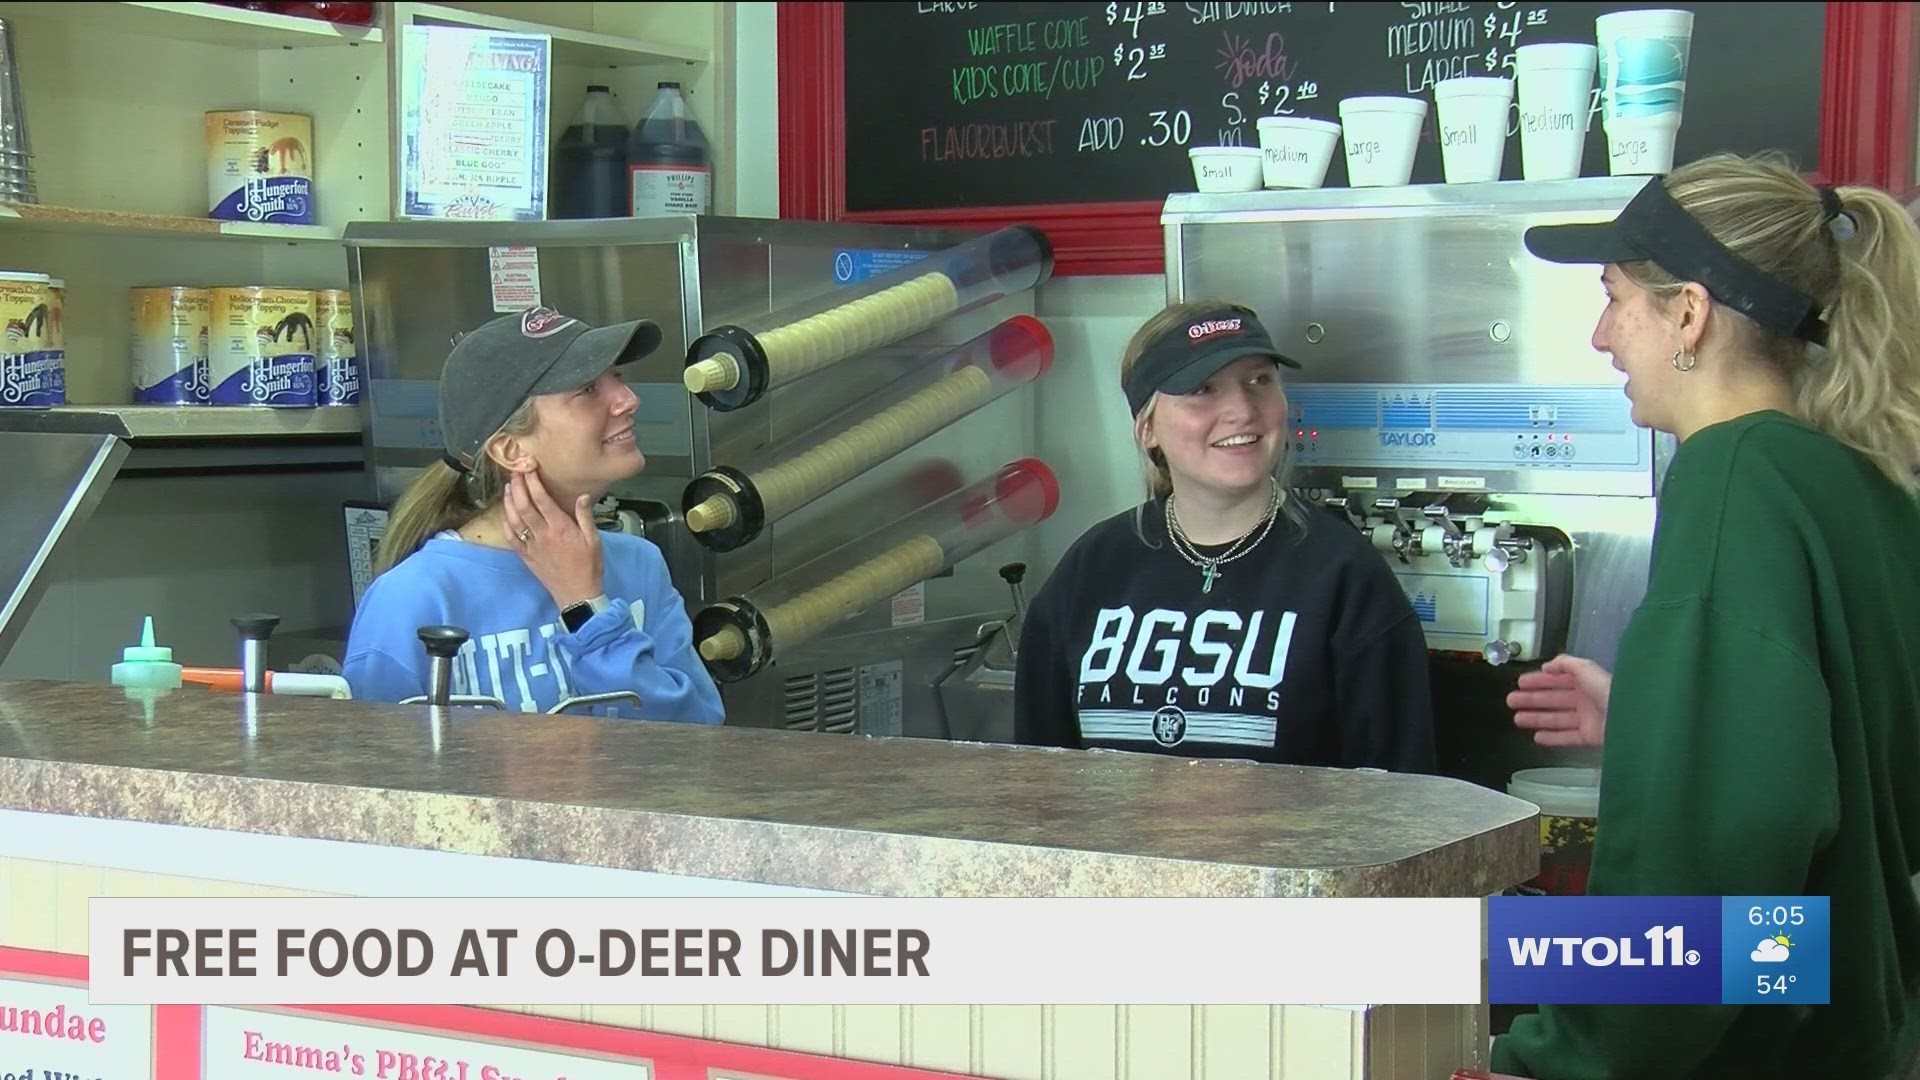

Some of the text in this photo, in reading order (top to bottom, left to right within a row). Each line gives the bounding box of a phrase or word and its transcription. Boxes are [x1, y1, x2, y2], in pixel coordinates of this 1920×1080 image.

[968, 21, 1037, 56] WAFFLE
[1044, 17, 1090, 50] CONE
[1387, 17, 1475, 58] MEDIUM
[952, 66, 999, 105] KIDS
[255, 119, 280, 129] Fudge
[922, 110, 1192, 160] FLAVORBURST ADD .30
[1443, 125, 1477, 147] Small
[483, 148, 518, 157] CHERRY
[1347, 141, 1381, 164] Large
[1611, 138, 1647, 165] Large
[455, 160, 479, 168] BLUE
[1202, 165, 1232, 178] Small
[249, 178, 309, 201] Hungerford
[666, 173, 695, 184] PHILLIPS
[247, 195, 285, 221] Smith
[229, 303, 254, 312] Fudge
[254, 357, 315, 381] Hungerford
[252, 374, 291, 401] Smith
[1379, 432, 1436, 446] TAYLOR
[1079, 605, 1298, 689] BGSU
[1077, 684, 1280, 711] FALCONS
